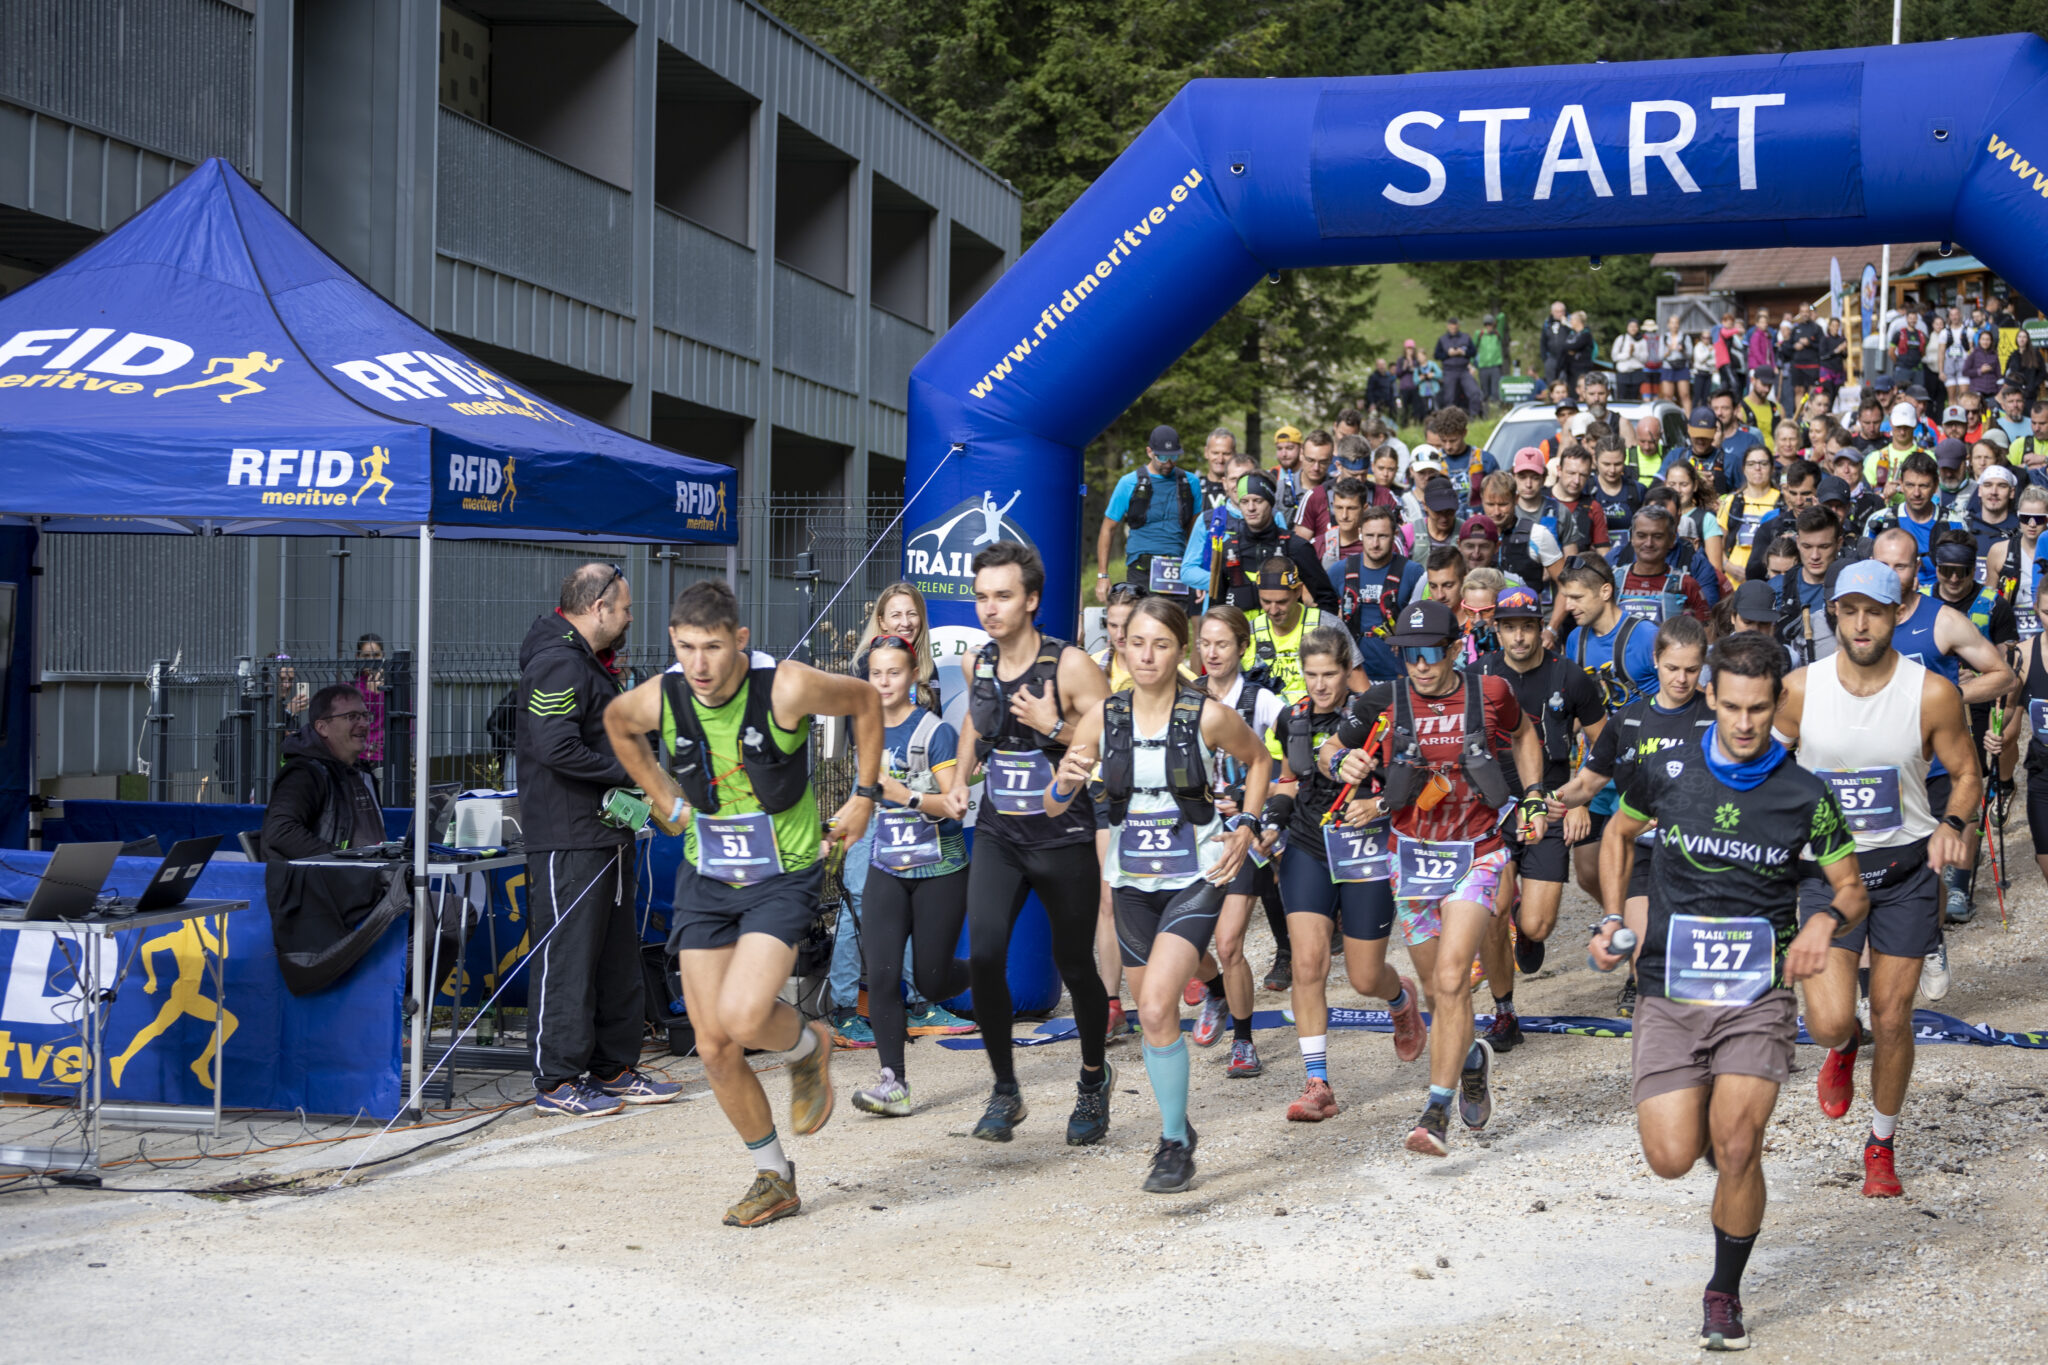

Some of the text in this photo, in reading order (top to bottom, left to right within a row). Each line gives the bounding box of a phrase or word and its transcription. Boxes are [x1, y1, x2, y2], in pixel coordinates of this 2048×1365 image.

[1382, 93, 1786, 206] START
[969, 168, 1203, 399] www.rfidmeritve.eu
[332, 351, 505, 401] RFID
[448, 396, 541, 421] meritve
[227, 448, 354, 488] RFID
[449, 453, 502, 495] RFID
[262, 489, 347, 506] meritve
[462, 495, 498, 512] meritve
[675, 480, 716, 516] RFID
[686, 515, 715, 531] meritve
[907, 549, 977, 577] TRAIL
[1163, 567, 1179, 580] 65
[917, 581, 954, 594] ZELENE
[2019, 616, 2038, 629] 33
[1002, 769, 1031, 790] 77
[1831, 778, 1859, 786] TRAIL
[1840, 787, 1876, 809] 59
[1127, 819, 1155, 827] TRAIL
[721, 834, 751, 858] 51
[890, 825, 917, 846] 14
[1137, 828, 1172, 850] 23
[1348, 837, 1378, 859] 76
[1415, 857, 1457, 879] 122
[1691, 928, 1725, 940] TRAIL
[1692, 942, 1752, 970] 127
